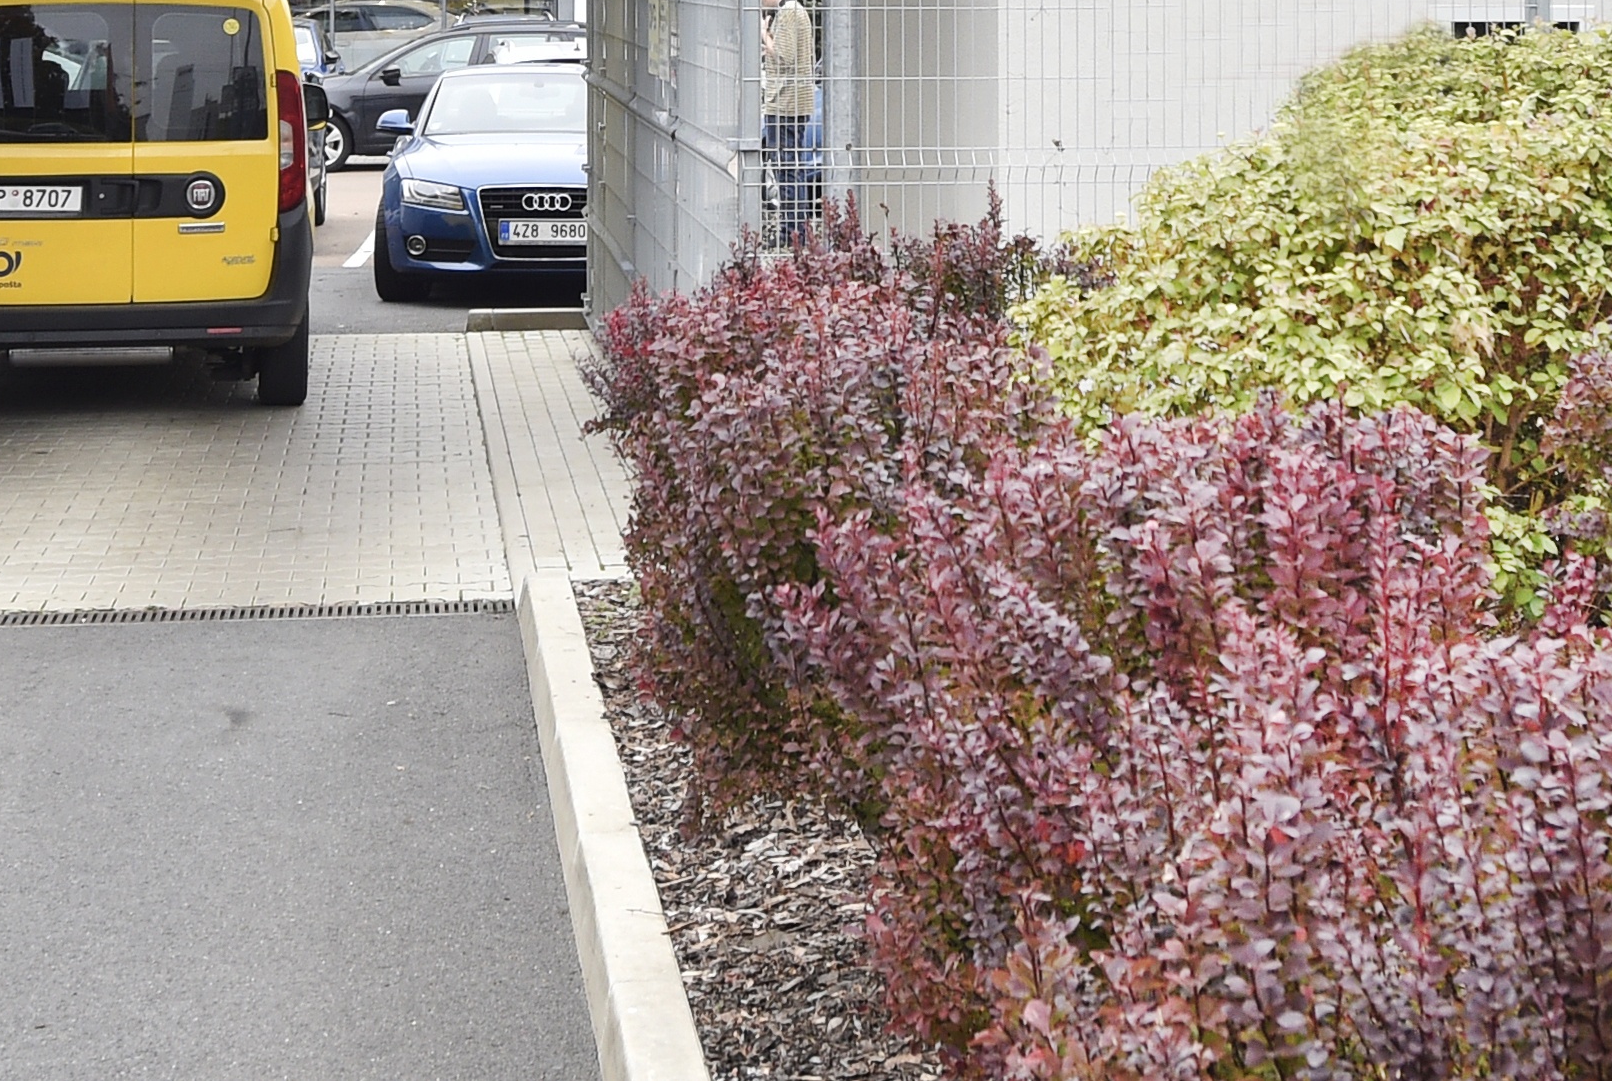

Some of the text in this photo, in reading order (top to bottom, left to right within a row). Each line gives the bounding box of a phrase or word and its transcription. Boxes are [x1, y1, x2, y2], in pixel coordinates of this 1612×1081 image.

[22, 188, 72, 208] 8707
[192, 188, 210, 202] FIAT
[512, 223, 539, 239] 4Z8
[550, 223, 586, 239] 9680
